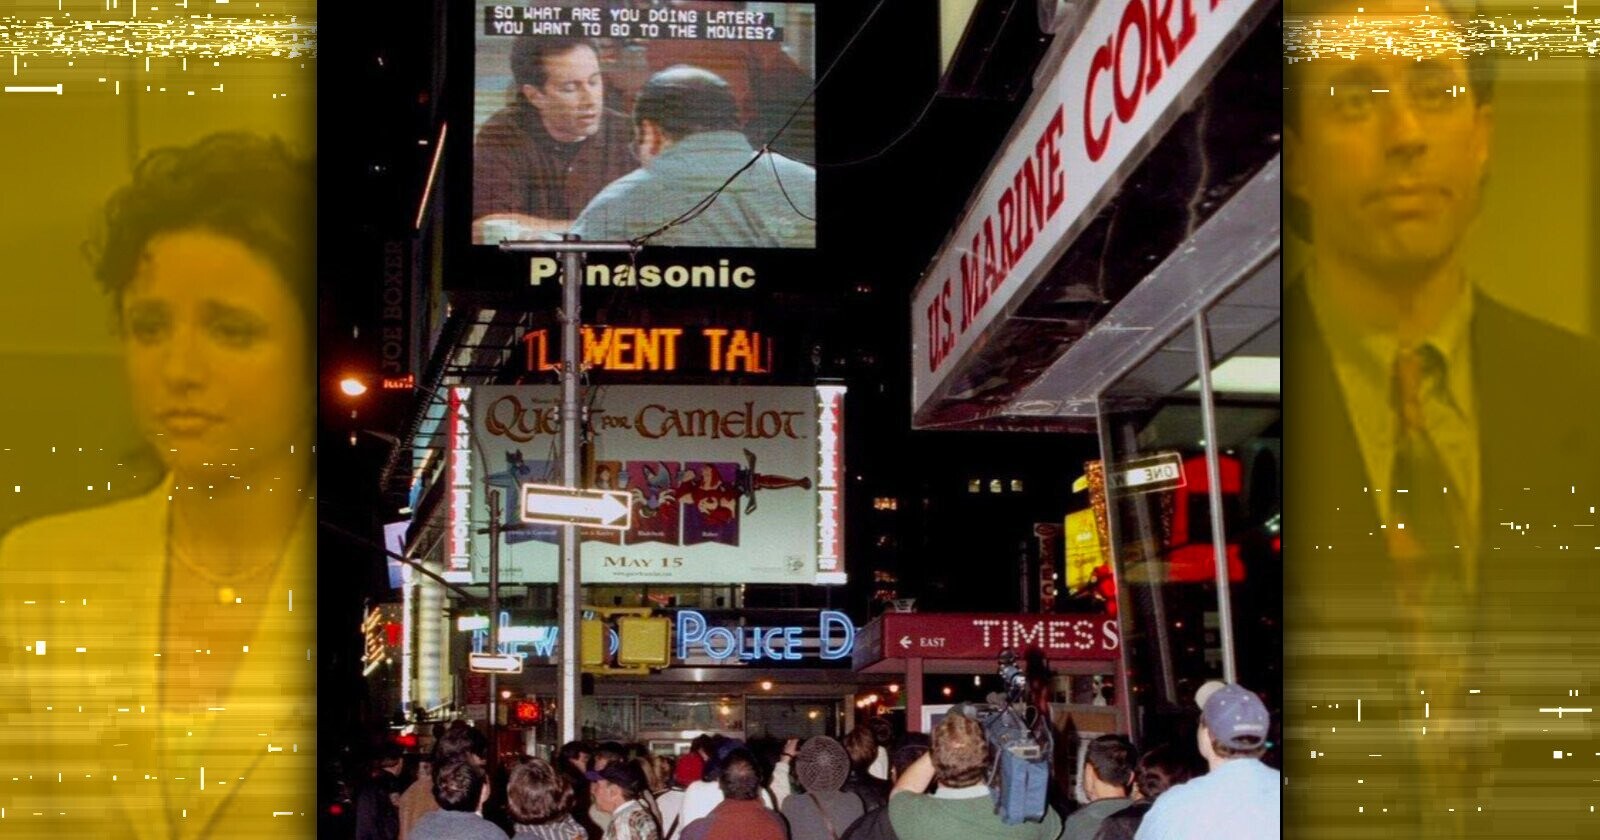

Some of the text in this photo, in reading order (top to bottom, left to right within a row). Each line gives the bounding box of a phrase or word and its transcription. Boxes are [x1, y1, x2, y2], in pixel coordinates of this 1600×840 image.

[493, 21, 775, 40] YOU WANT TO GO TO THE MOVIES?
[495, 6, 766, 25] SO WHAT ARE YOU DOING LATER?
[926, 277, 955, 374] U.S.
[959, 105, 1066, 335] MARINE
[382, 241, 404, 321] BOXER
[382, 327, 404, 374] JOE
[523, 326, 683, 372] TLMENT
[603, 556, 684, 569] MAY 15
[676, 610, 804, 661] POLICE
[919, 636, 946, 648] EAST
[972, 619, 1096, 651] TIMES
